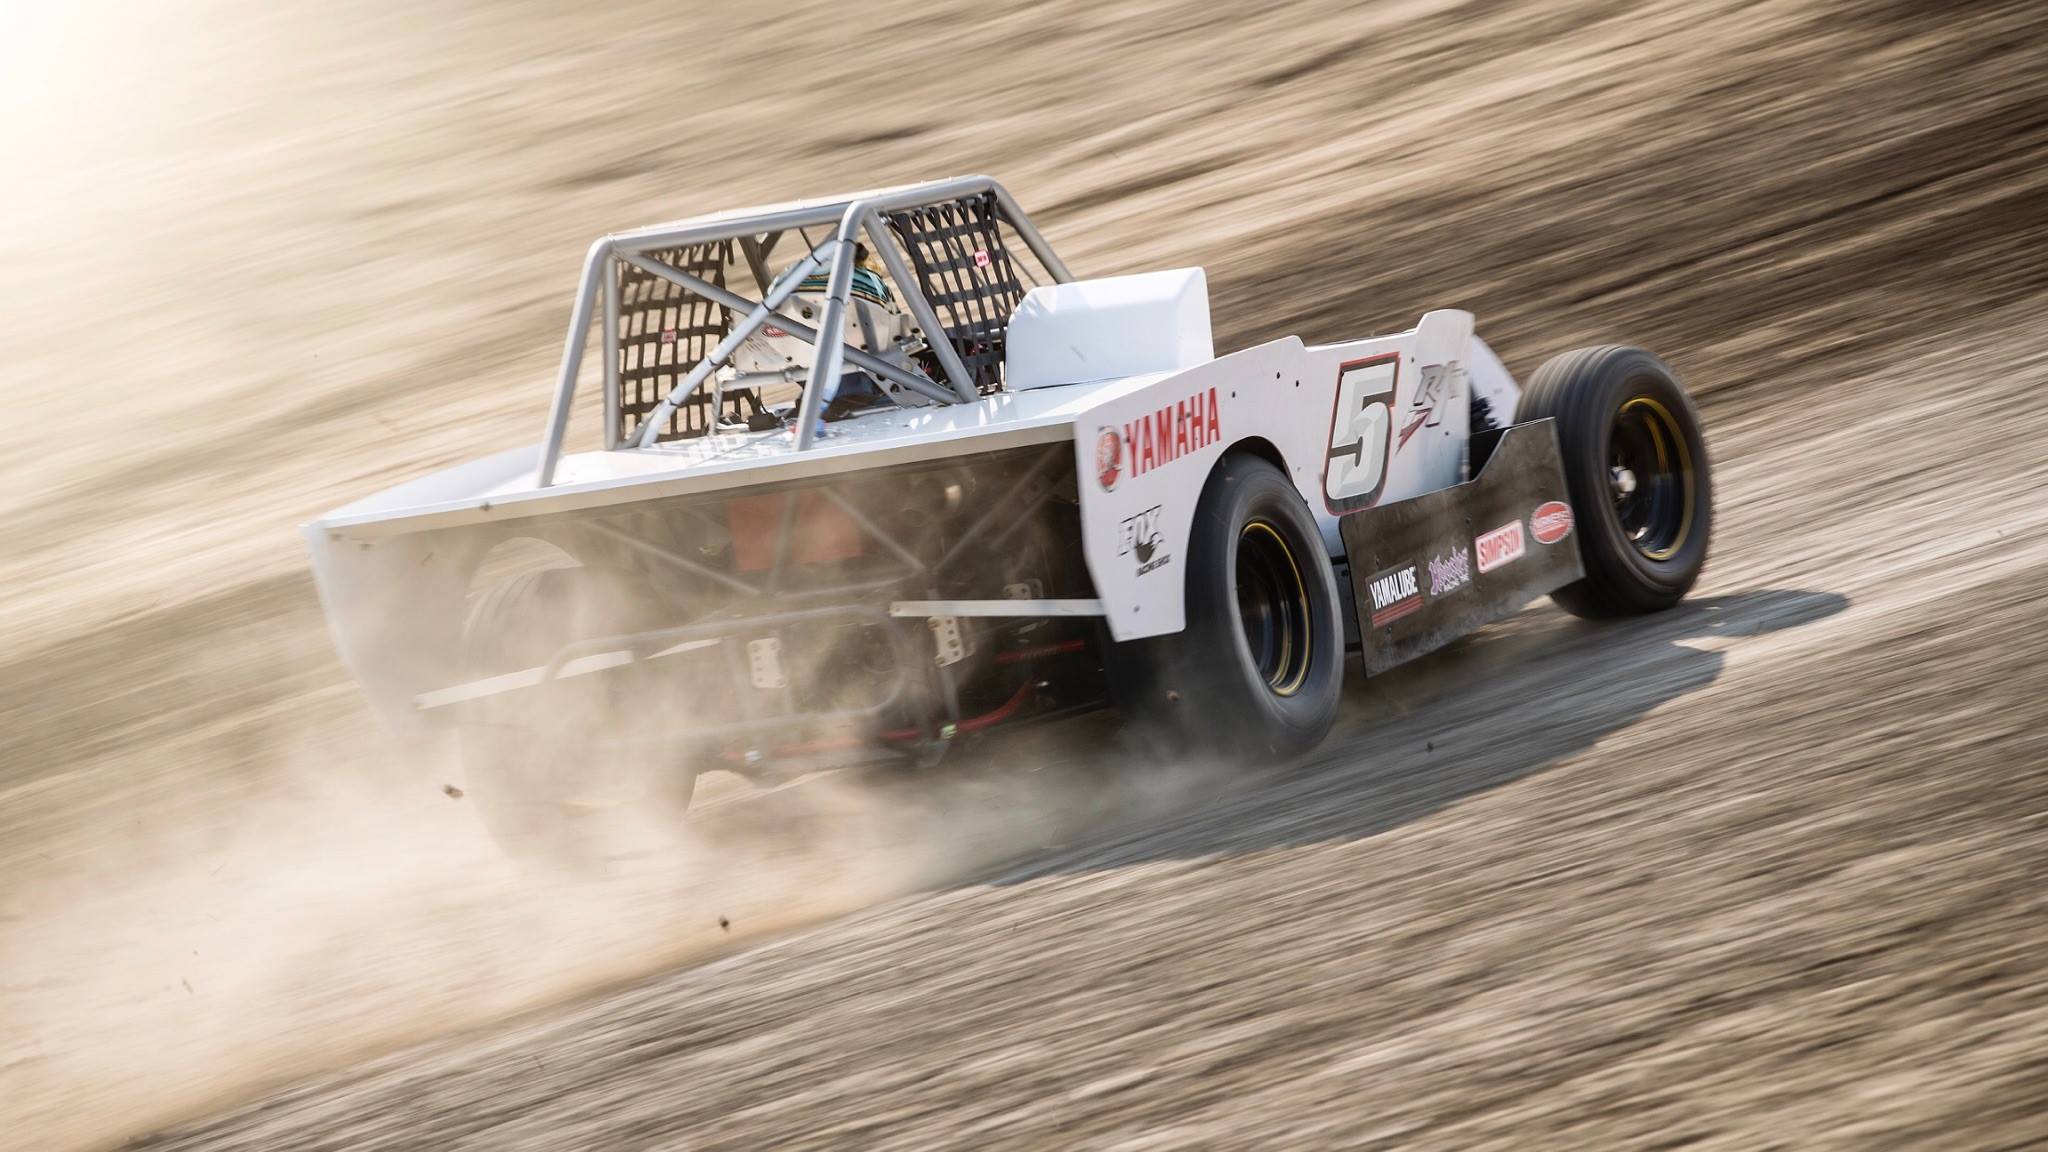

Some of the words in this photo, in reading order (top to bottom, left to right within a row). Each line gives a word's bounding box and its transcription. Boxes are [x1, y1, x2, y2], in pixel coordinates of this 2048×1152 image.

[1124, 387, 1220, 478] YAMAHA
[1325, 353, 1399, 515] 5
[1480, 530, 1521, 567] SIMPSON
[1369, 565, 1419, 610] YAMALUBE
